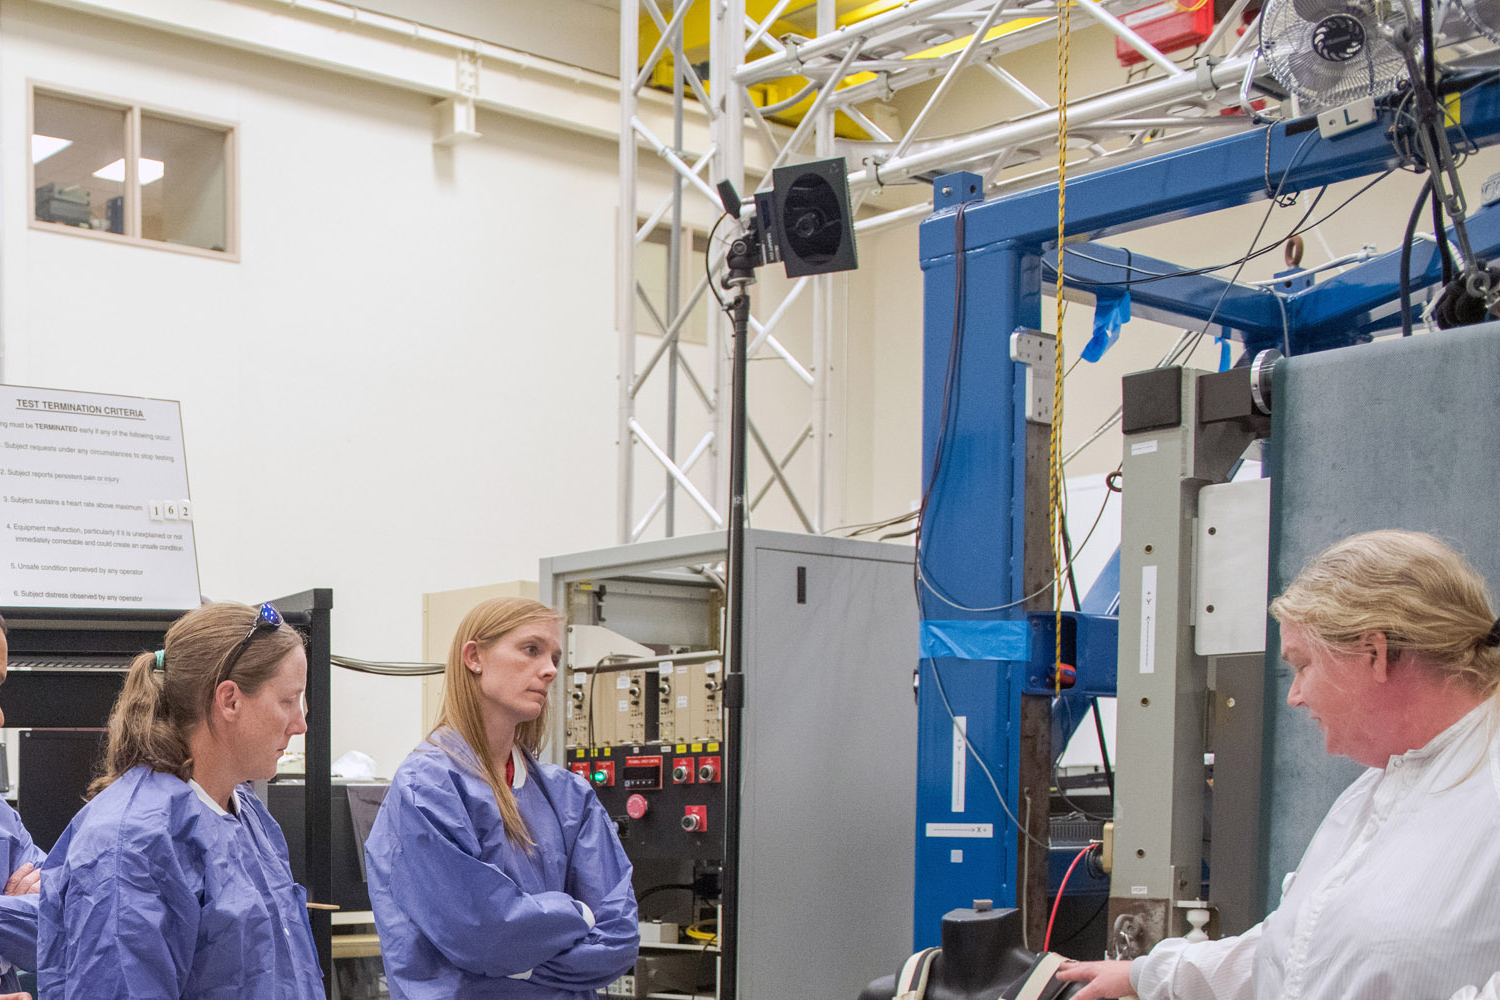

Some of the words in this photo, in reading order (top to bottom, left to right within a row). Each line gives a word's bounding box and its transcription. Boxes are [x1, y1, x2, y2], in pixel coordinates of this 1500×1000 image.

[1343, 109, 1359, 125] L
[16, 399, 40, 408] TEST
[42, 401, 102, 414] TERMINATION
[104, 406, 144, 417] CRITERIA
[35, 423, 78, 432] TERMINATED
[129, 431, 154, 440] following
[4, 442, 28, 450] Subject
[29, 444, 56, 452] requests
[90, 449, 132, 458] circumstances
[141, 453, 154, 461] stop
[155, 454, 174, 463] testing
[7, 469, 30, 477] Subject
[32, 471, 53, 479] reports
[104, 476, 119, 484] injury
[10, 496, 33, 504] Subject
[35, 498, 60, 506] sustains
[13, 523, 46, 533] Equipment
[47, 525, 83, 534] malfunction,
[84, 528, 115, 536] particularly
[132, 531, 165, 540] unexplained
[15, 536, 50, 544] immediately
[52, 538, 84, 546] correctable
[159, 544, 183, 552] condition
[41, 564, 68, 572] condition
[21, 590, 44, 599] Subject
[45, 591, 69, 599] distress
[69, 592, 97, 600] observed
[98, 593, 106, 601] by
